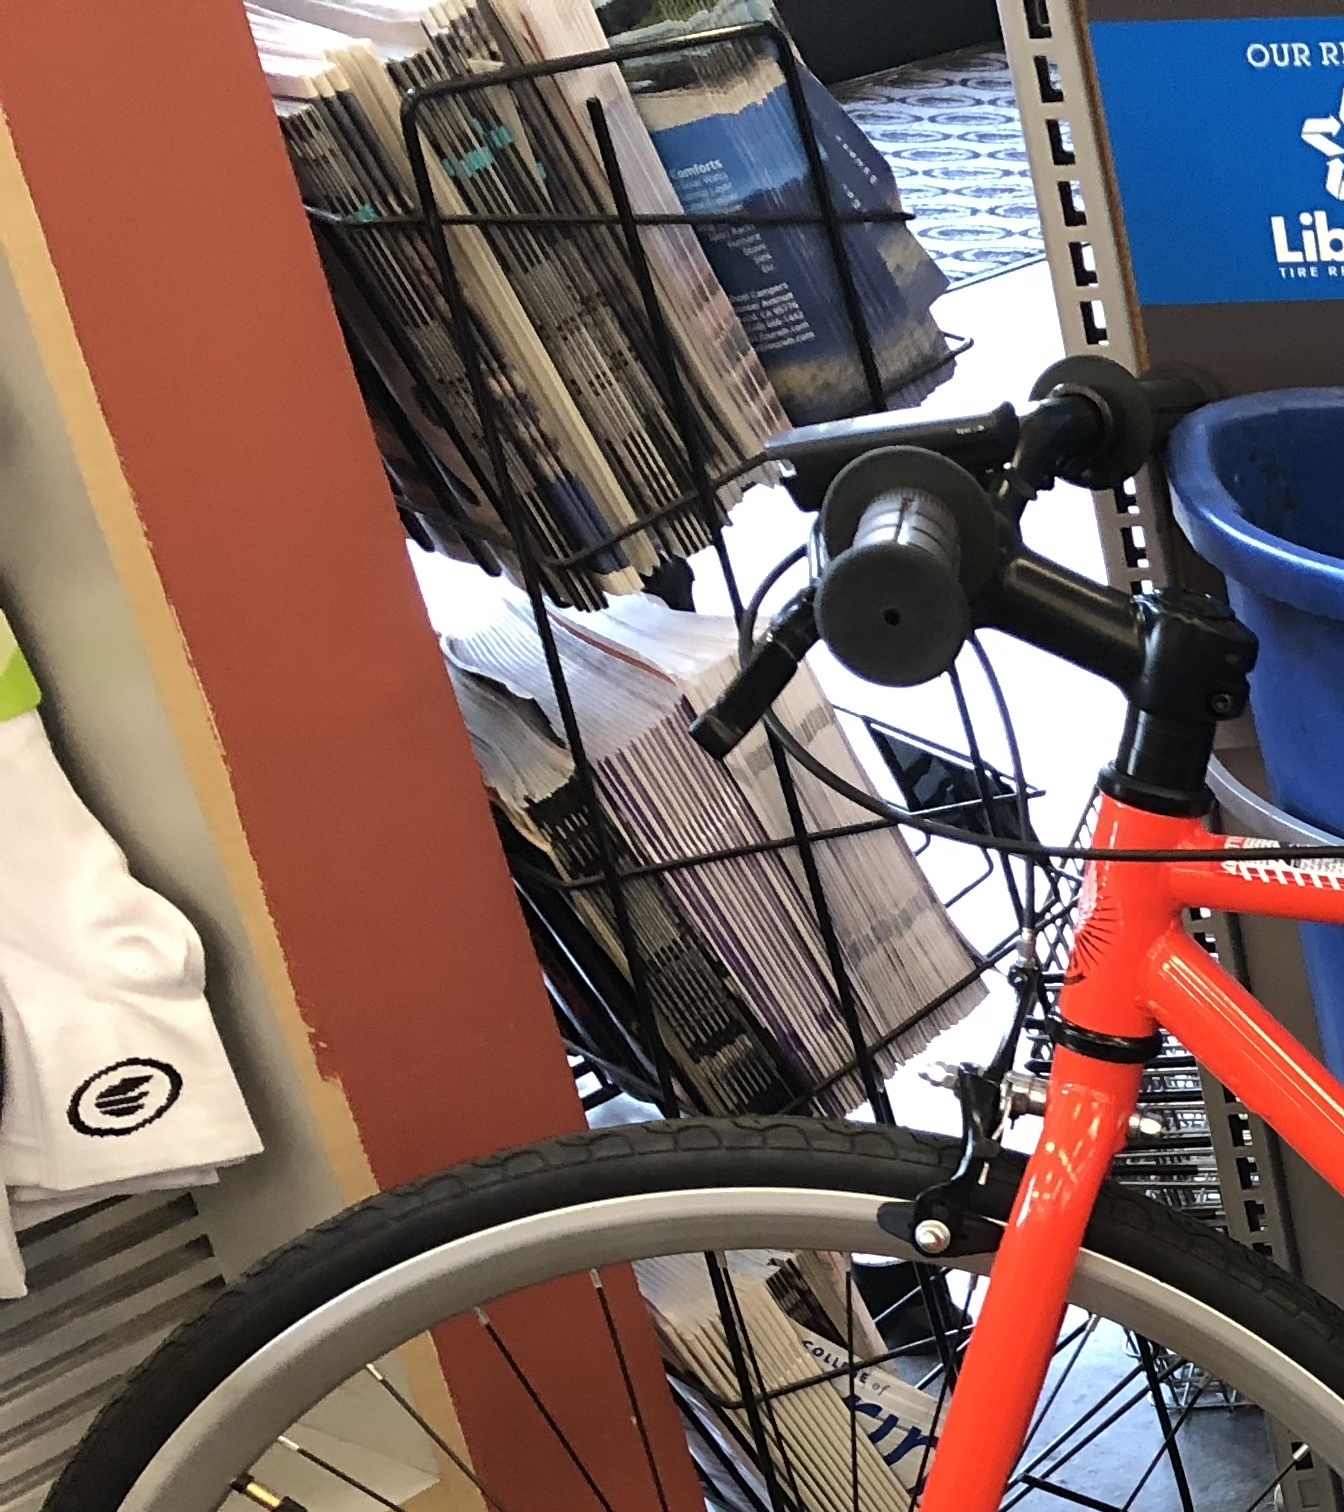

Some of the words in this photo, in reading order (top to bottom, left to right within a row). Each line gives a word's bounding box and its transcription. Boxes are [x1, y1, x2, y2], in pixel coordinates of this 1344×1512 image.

[1246, 42, 1312, 68] OUR
[1278, 264, 1319, 279] TIRE
[871, 1382, 891, 1396] of
